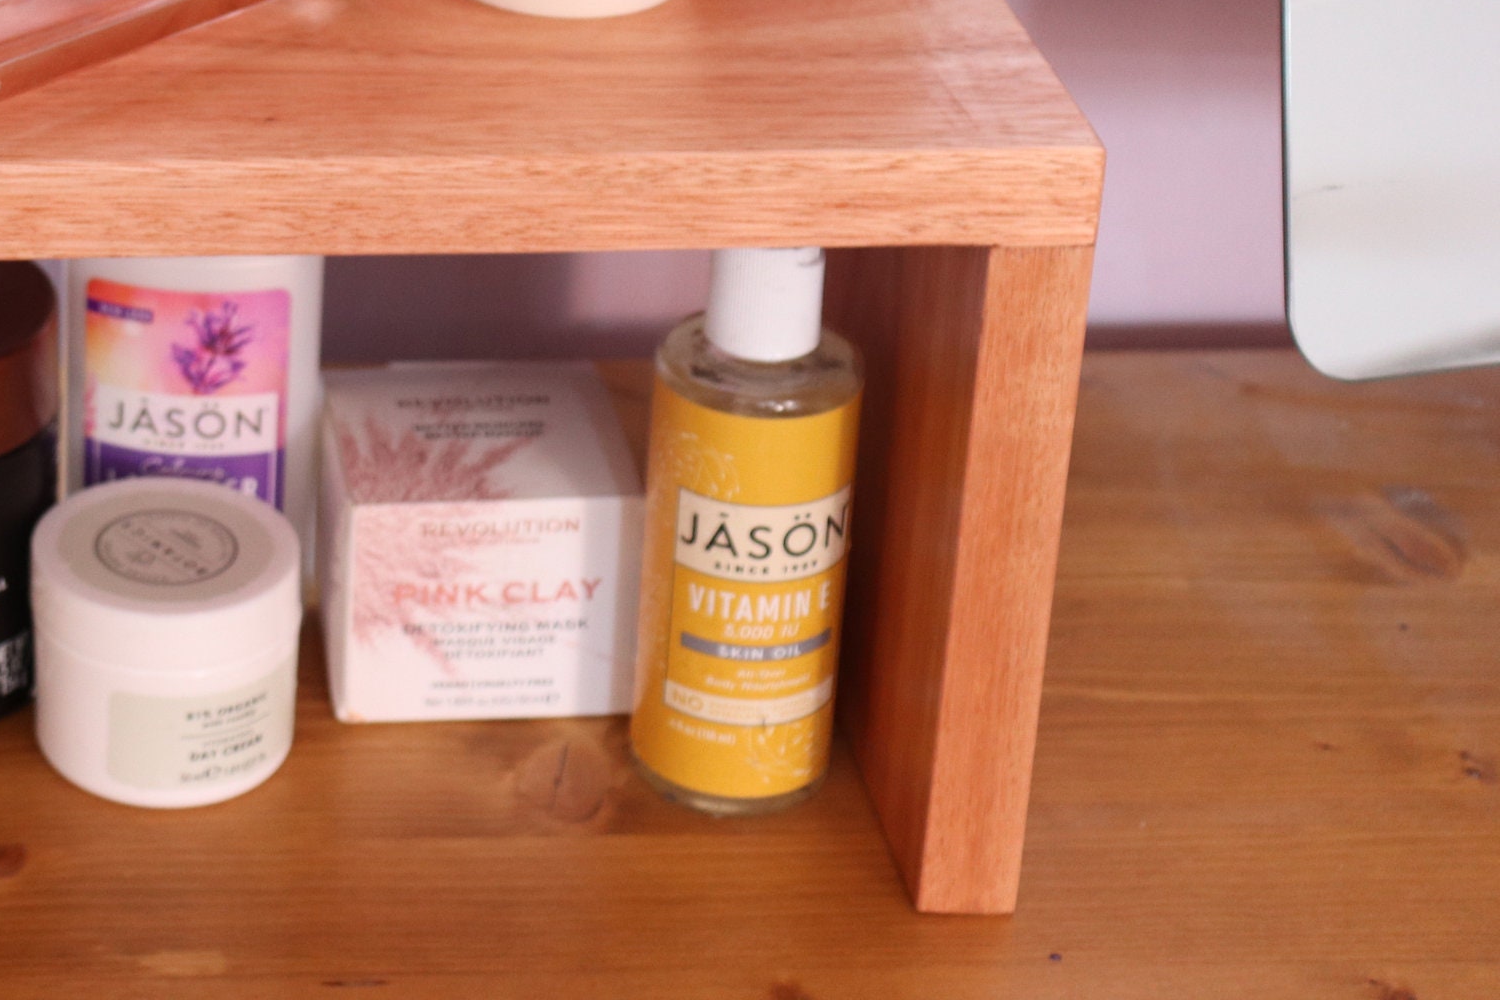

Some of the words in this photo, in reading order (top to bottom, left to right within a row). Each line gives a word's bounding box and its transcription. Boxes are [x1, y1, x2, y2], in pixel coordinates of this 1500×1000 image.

[420, 517, 581, 538] REVOLUTION
[714, 560, 770, 575] SINCE
[393, 580, 490, 608] PINK
[501, 576, 604, 605] CLAY
[688, 582, 812, 623] VITAMIN
[819, 579, 831, 611] E
[536, 618, 590, 631] MASK
[716, 643, 764, 660] SKIN
[773, 644, 800, 659] OIL
[190, 749, 217, 762] DAY
[222, 733, 263, 757] CREAM
